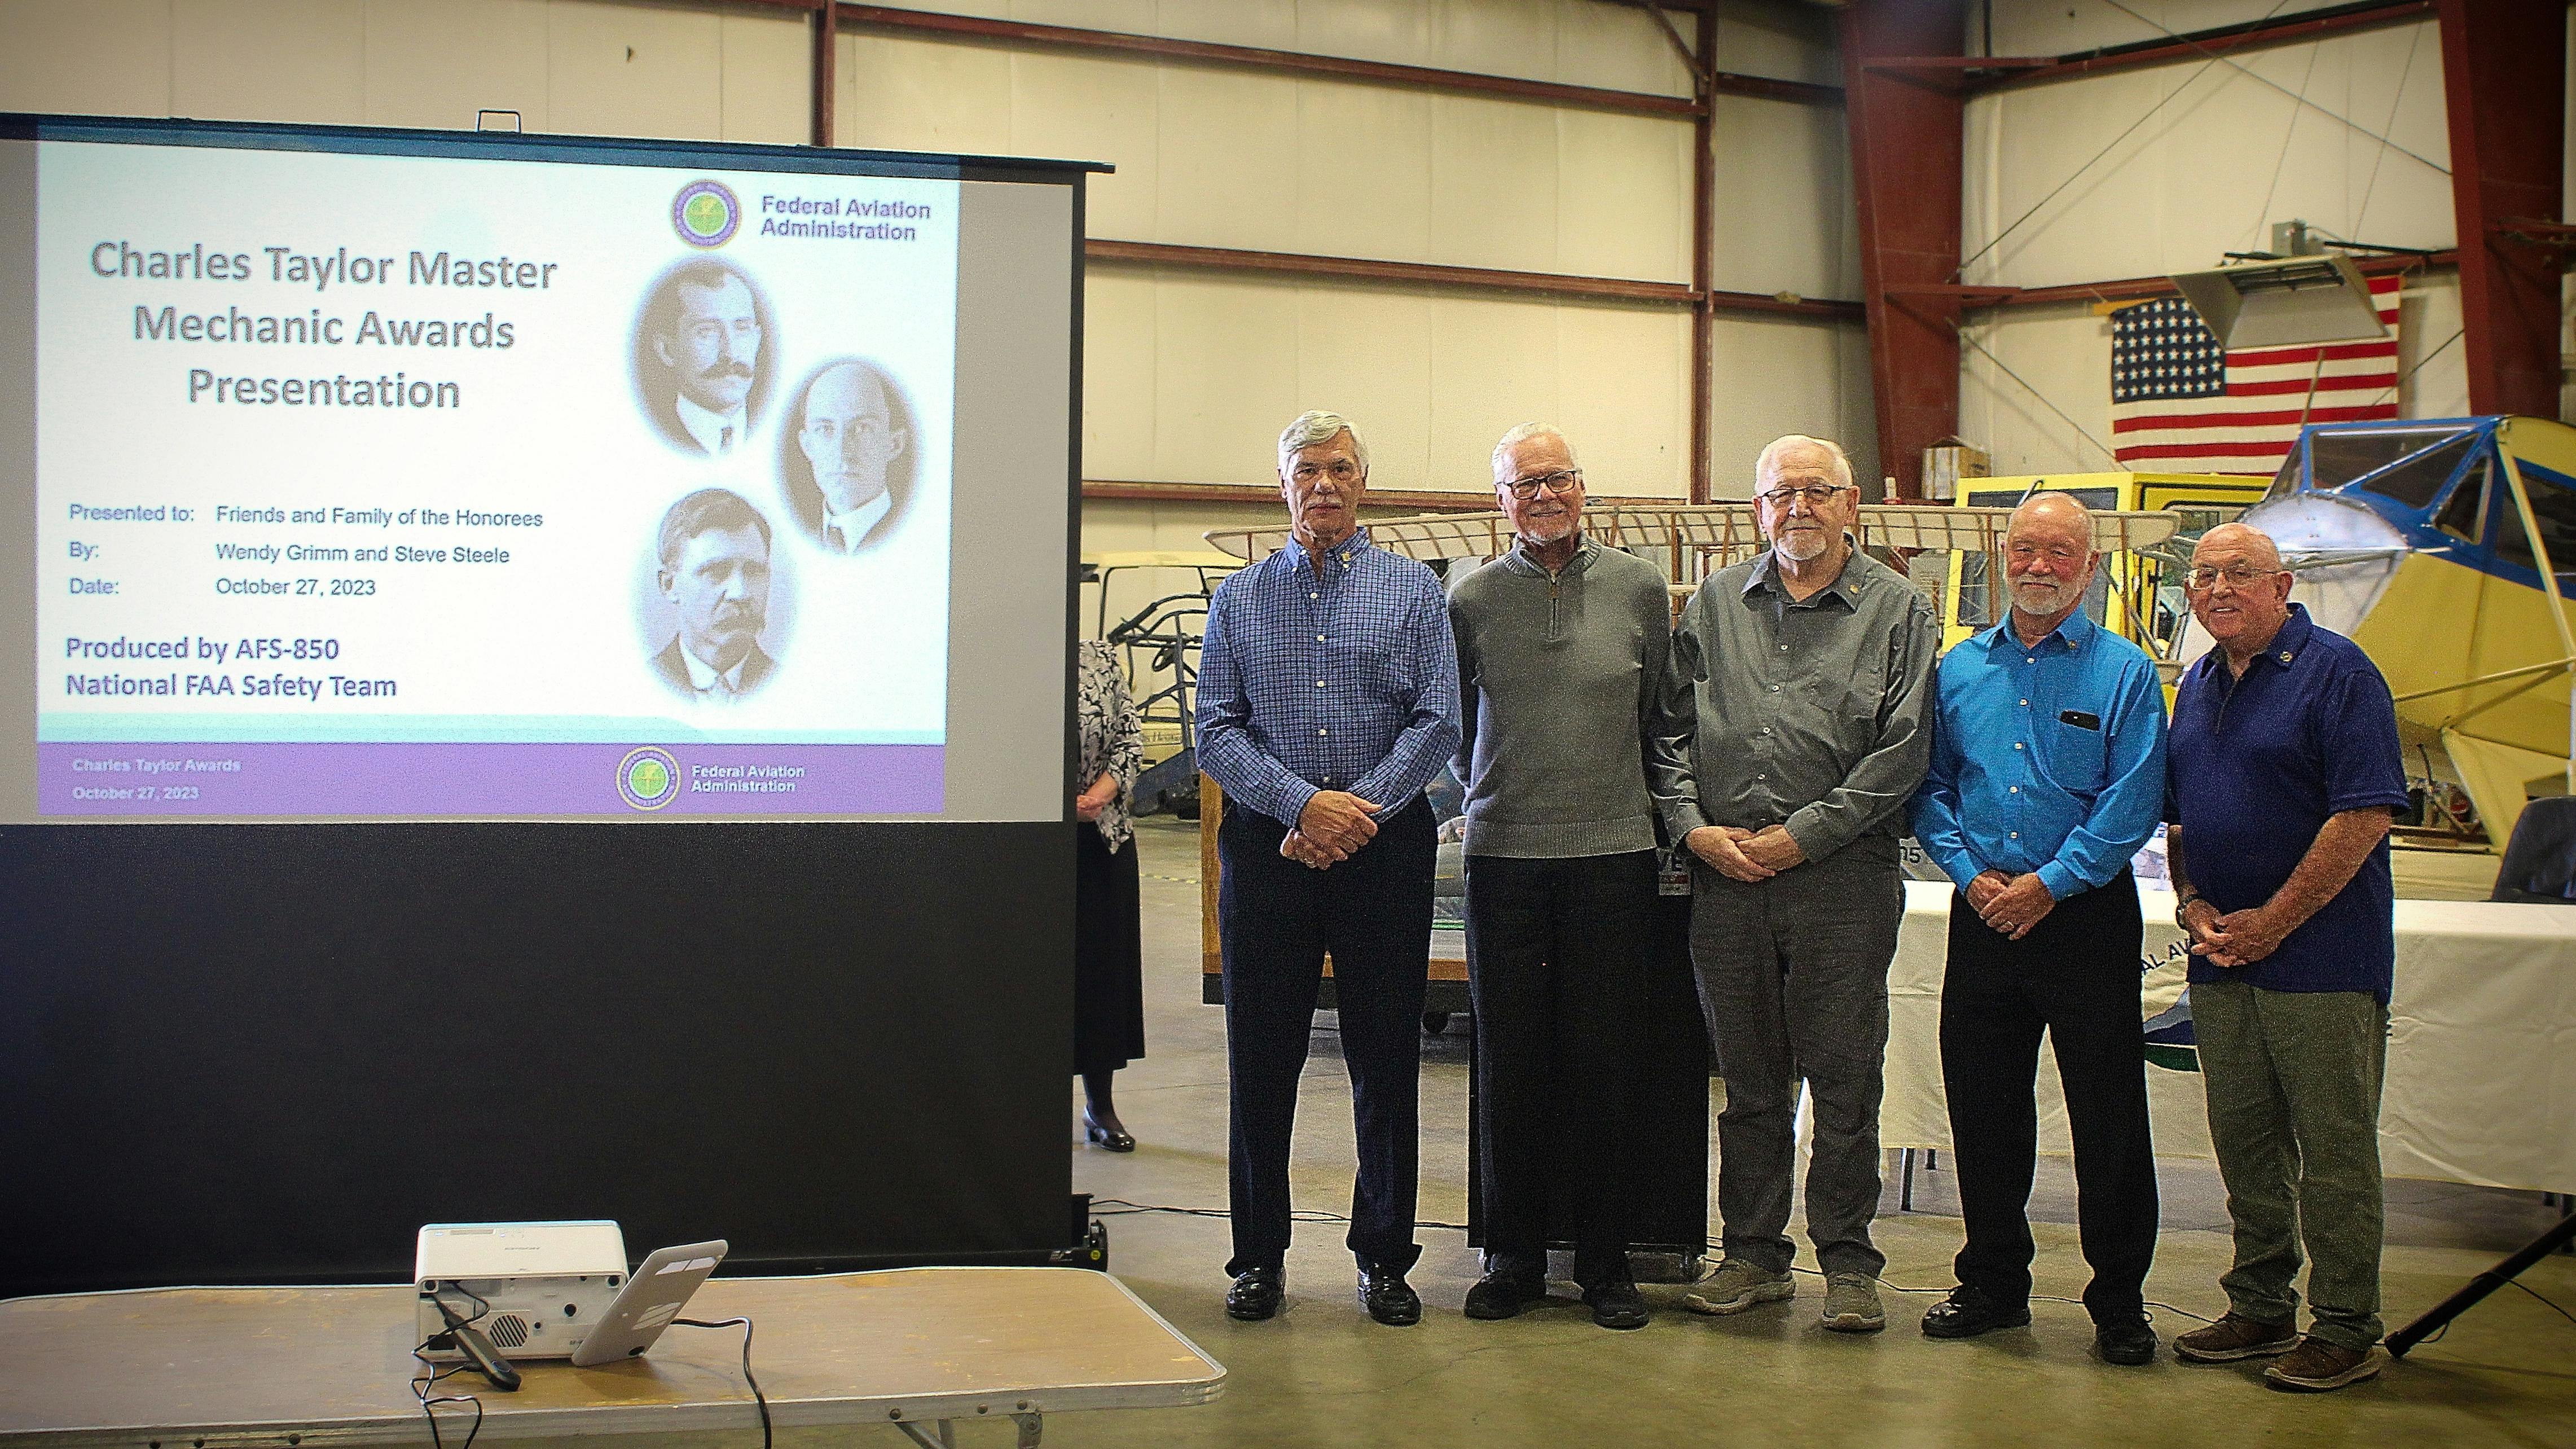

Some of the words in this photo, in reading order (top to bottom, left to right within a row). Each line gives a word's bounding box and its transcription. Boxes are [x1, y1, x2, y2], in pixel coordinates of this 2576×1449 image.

[763, 196, 839, 215] Federal
[846, 199, 930, 219] Aviation
[762, 218, 916, 241] Administration
[92, 242, 250, 280] Charles
[265, 246, 394, 291] Taylor
[410, 252, 557, 288] Master
[135, 305, 342, 344] Mechanic
[357, 311, 515, 349] Awards
[189, 368, 460, 407] Presentation
[71, 504, 165, 521] Presented
[173, 505, 195, 521] to:
[217, 506, 285, 522] Friends
[292, 507, 325, 522] and
[333, 508, 392, 526] Family
[399, 508, 416, 524] of
[423, 510, 450, 524] the
[457, 510, 543, 525] Honorees
[71, 542, 99, 560] By:
[217, 543, 280, 562] Wendy
[287, 544, 348, 560] Grimm
[355, 545, 388, 560] and
[395, 546, 446, 561] Steve
[452, 546, 510, 562] Steele
[71, 577, 119, 594] Date:
[217, 577, 290, 594] October
[297, 578, 323, 596] 27,
[331, 579, 376, 595] 2023
[66, 636, 188, 658] Produced
[199, 636, 227, 662] by
[236, 638, 339, 660] AFS-850
[66, 673, 175, 695] National
[186, 675, 235, 695] FAA
[242, 673, 322, 701] Safety
[329, 675, 397, 696] Team
[73, 759, 131, 771] Charles
[137, 759, 181, 774] Taylor
[184, 759, 241, 771] Awards
[692, 765, 744, 777] Federal
[748, 765, 805, 778] Aviation
[73, 787, 132, 800] October
[164, 788, 200, 800] 2023
[691, 780, 795, 792] Administration
